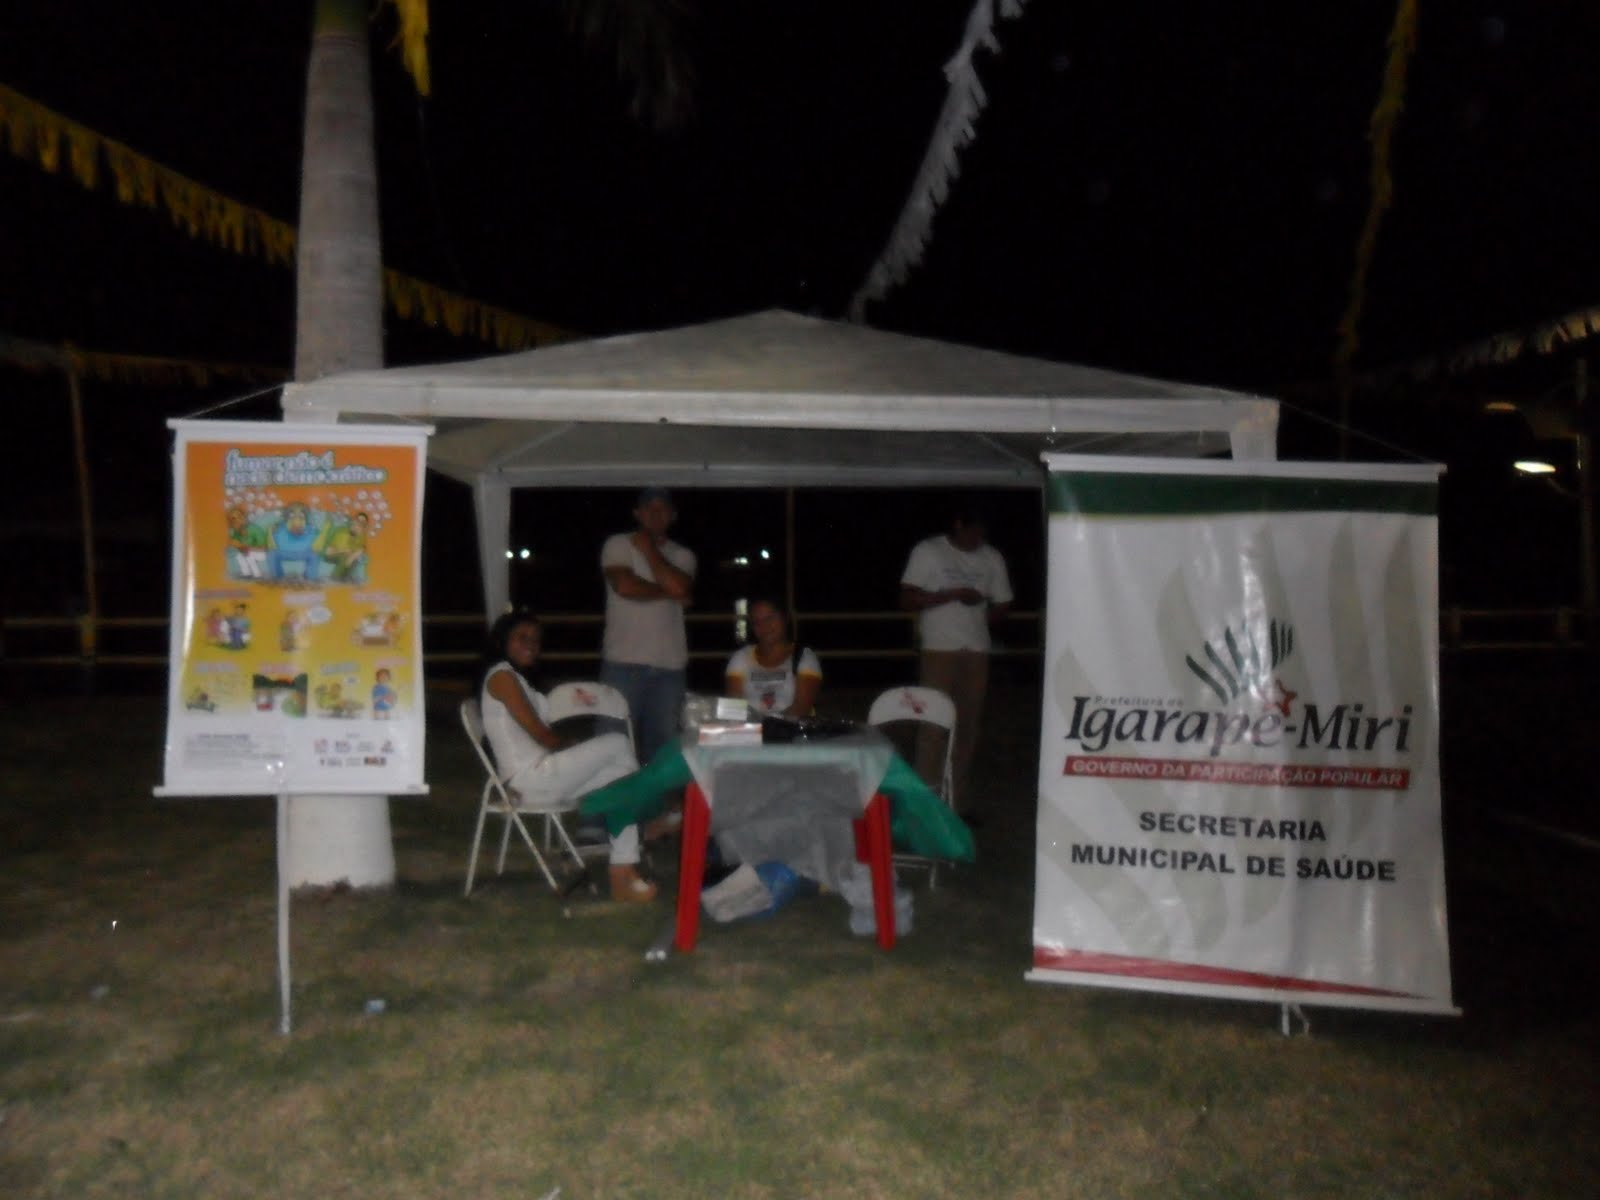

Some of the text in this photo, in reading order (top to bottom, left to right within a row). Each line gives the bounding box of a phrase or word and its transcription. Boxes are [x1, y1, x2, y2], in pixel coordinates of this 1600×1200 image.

[1071, 759, 1157, 776] GOVERNO
[1161, 763, 1186, 777] DA
[1320, 769, 1402, 785] POPULAR
[1139, 811, 1327, 841] SECRETARIA
[1071, 843, 1396, 881] MUNICIPAL DE SAÚDE
